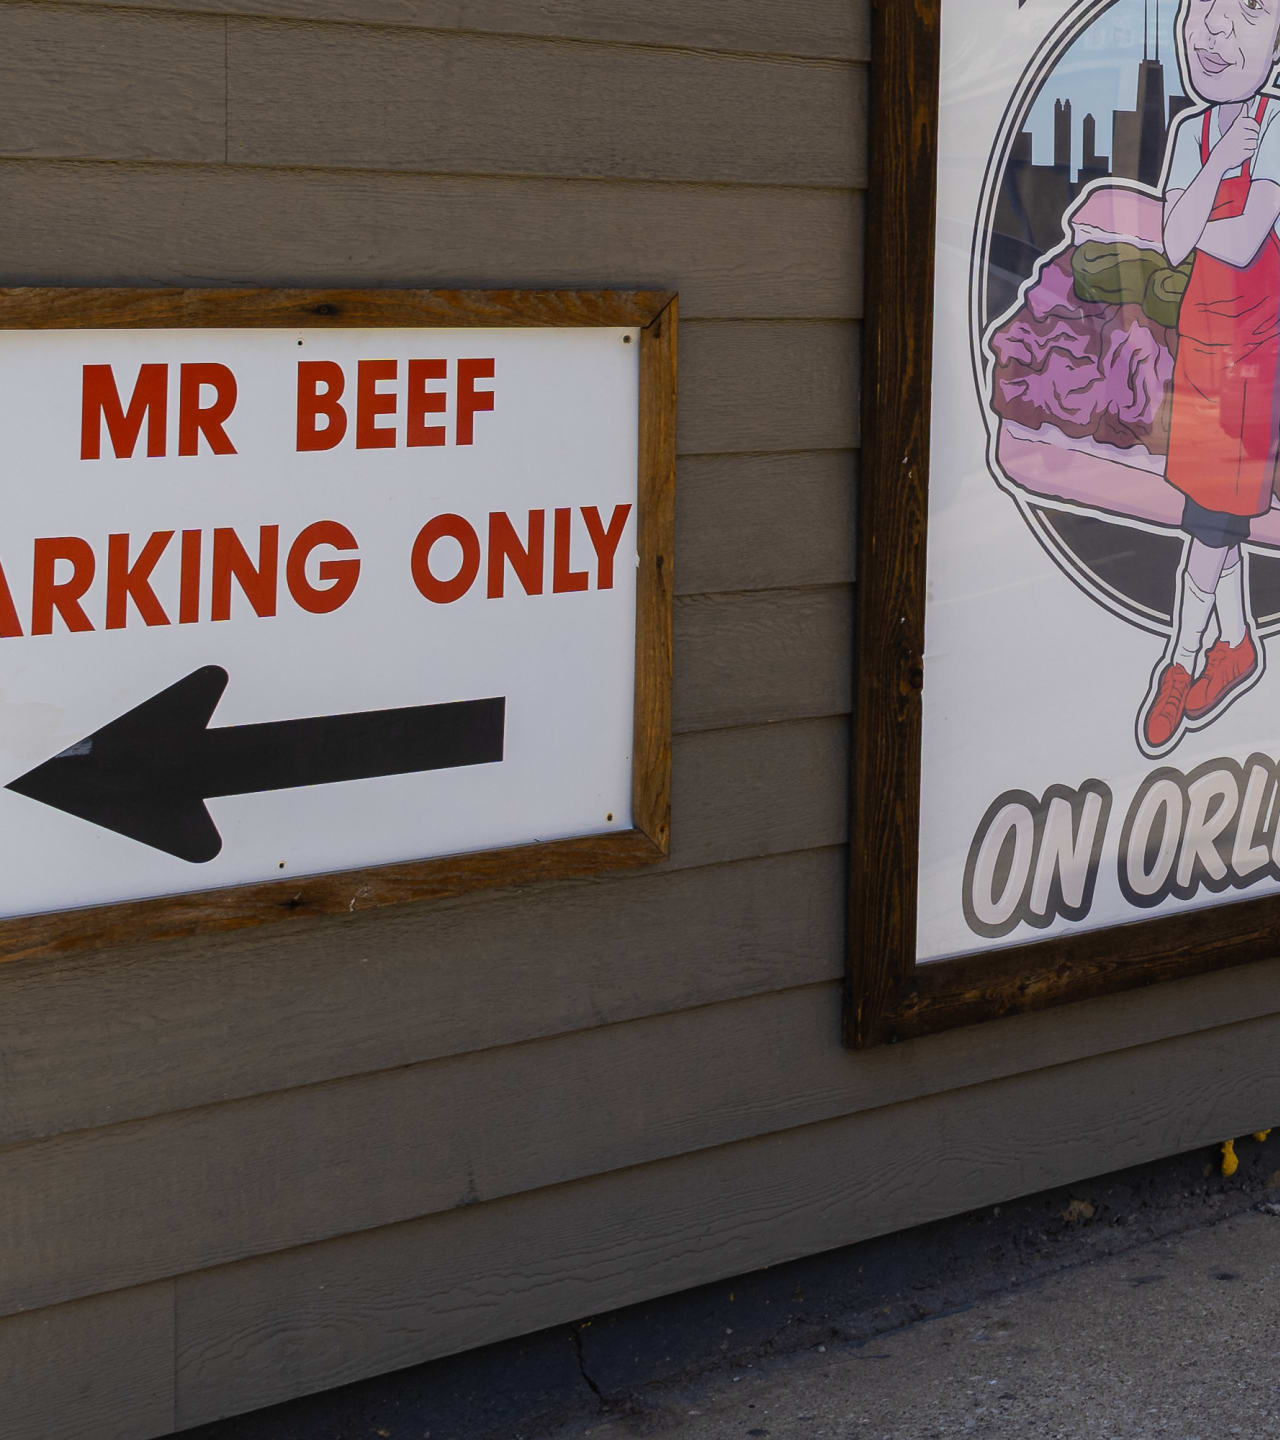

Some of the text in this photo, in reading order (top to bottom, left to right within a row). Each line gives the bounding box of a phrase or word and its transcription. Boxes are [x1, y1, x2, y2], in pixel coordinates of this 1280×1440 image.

[80, 357, 496, 460] MR BEEF
[410, 503, 633, 605] ONLY
[962, 777, 1113, 939] ON
